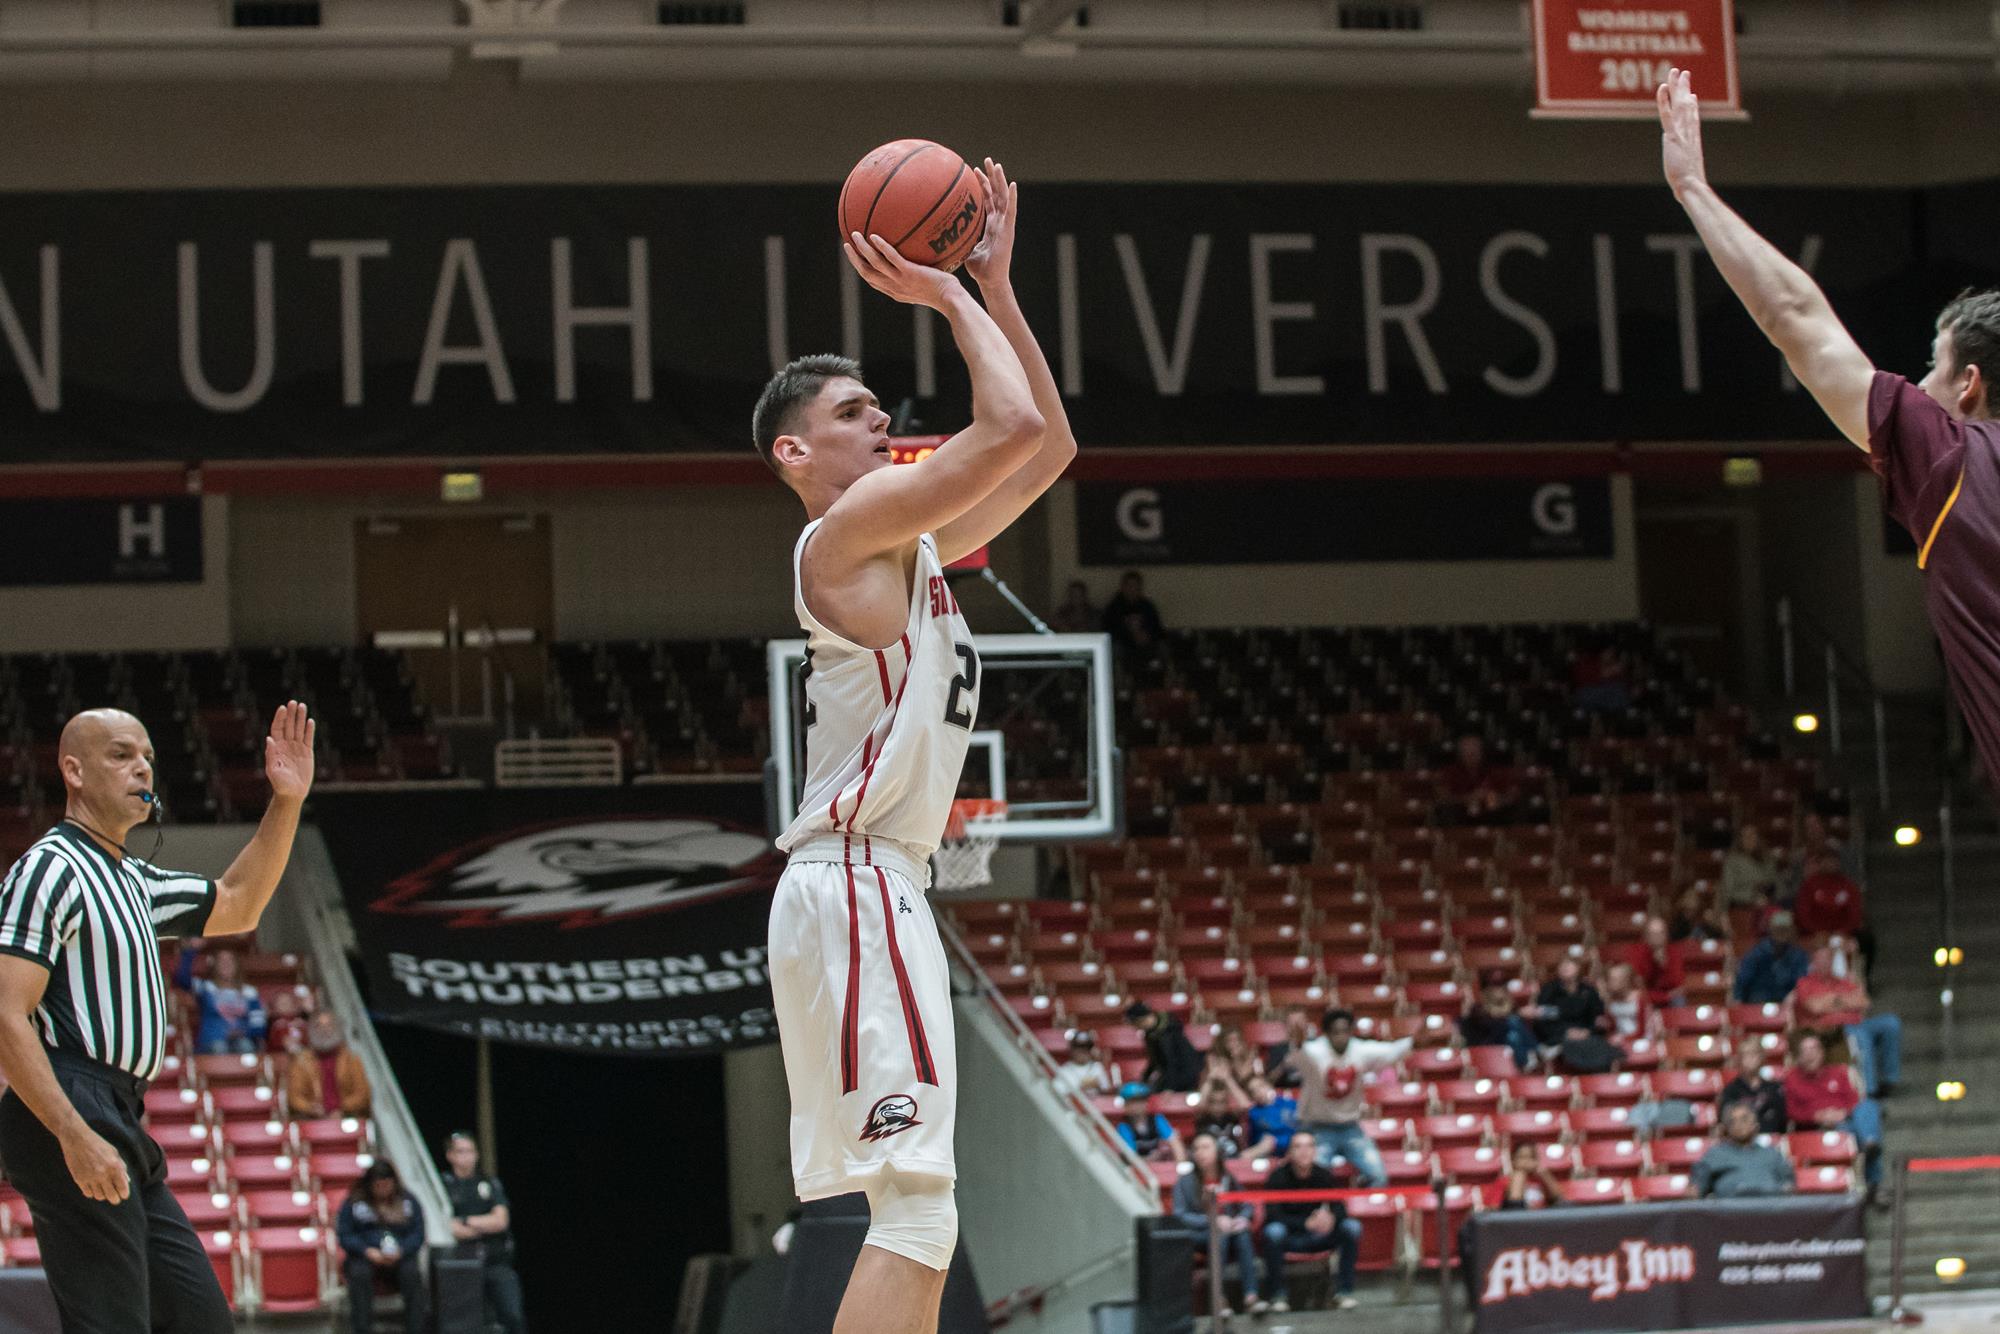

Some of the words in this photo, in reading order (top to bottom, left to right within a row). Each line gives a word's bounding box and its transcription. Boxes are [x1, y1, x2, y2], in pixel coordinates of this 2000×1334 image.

[1567, 32, 1704, 54] BASKETBALL
[1577, 9, 1689, 31] WOMEN'S
[928, 192, 978, 255] NCAA
[177, 236, 654, 412] UTAH
[764, 231, 1824, 396] UIVERSIT
[117, 504, 166, 556] H
[1114, 488, 1164, 542] G
[1530, 483, 1577, 535] G
[388, 951, 707, 984] SOUTHERN
[392, 963, 769, 1006] THUNDERBI
[1482, 1246, 1622, 1304] Abbey
[1621, 1238, 1697, 1292] Inn
